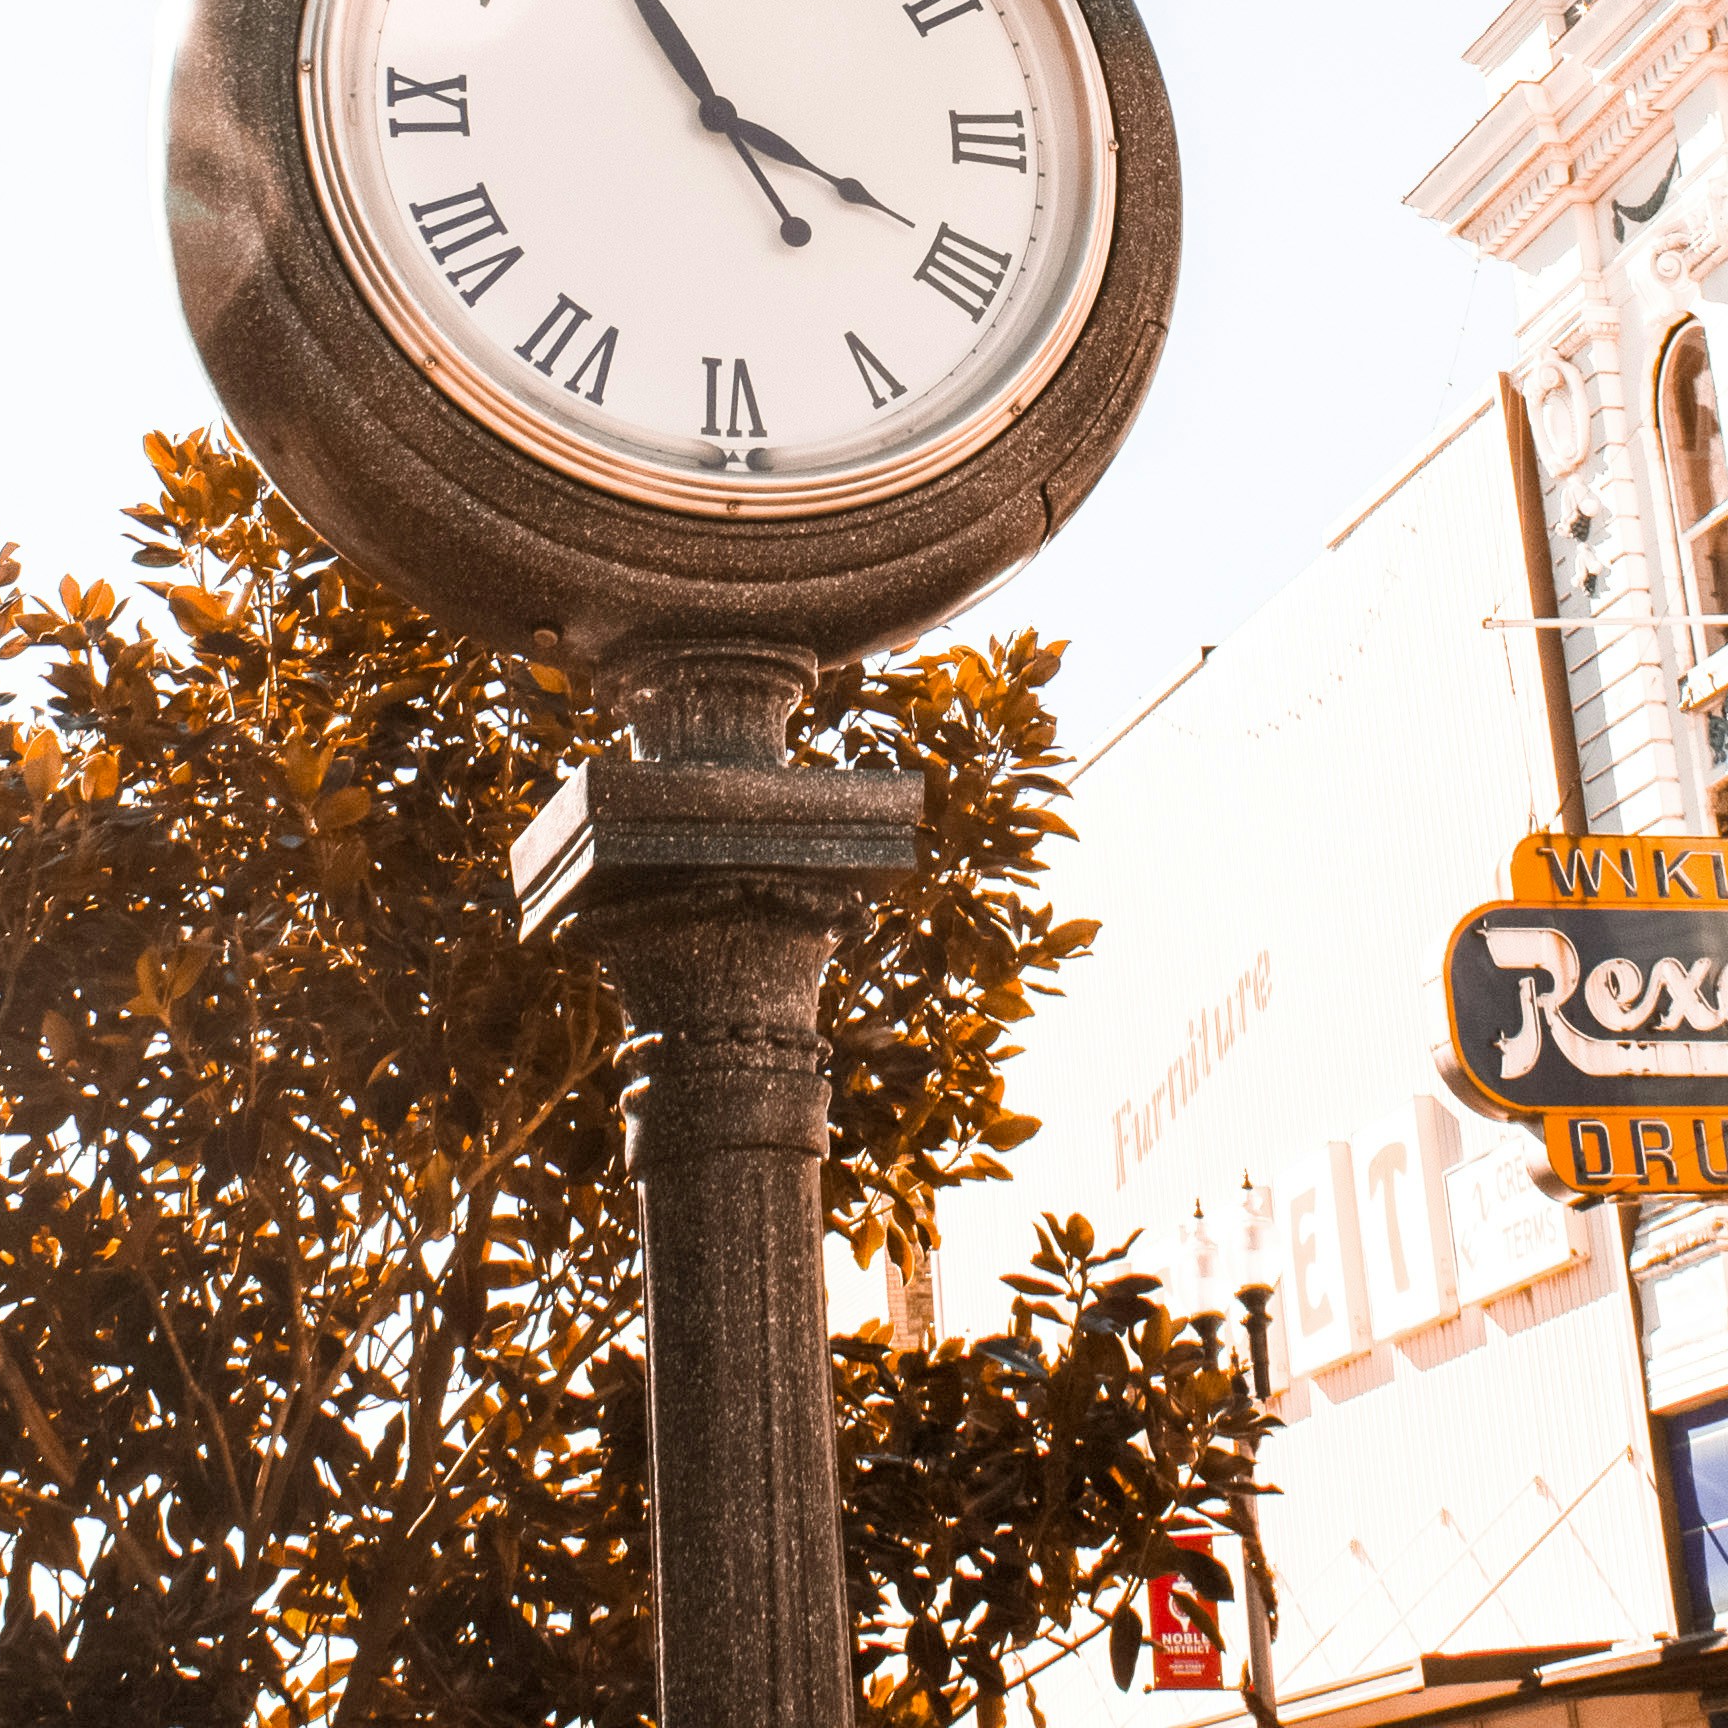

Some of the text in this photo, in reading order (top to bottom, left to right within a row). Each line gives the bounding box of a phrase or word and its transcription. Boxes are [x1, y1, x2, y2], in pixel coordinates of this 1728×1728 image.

[387, 67, 470, 137] IX
[409, 182, 526, 308] VIII
[514, 292, 622, 405] VII
[843, 331, 907, 409] V
[699, 357, 767, 437] VI
[1113, 950, 1272, 1192] Furniture
[1496, 1155, 1535, 1201] CRE
[1503, 1207, 1556, 1263] TERMS
